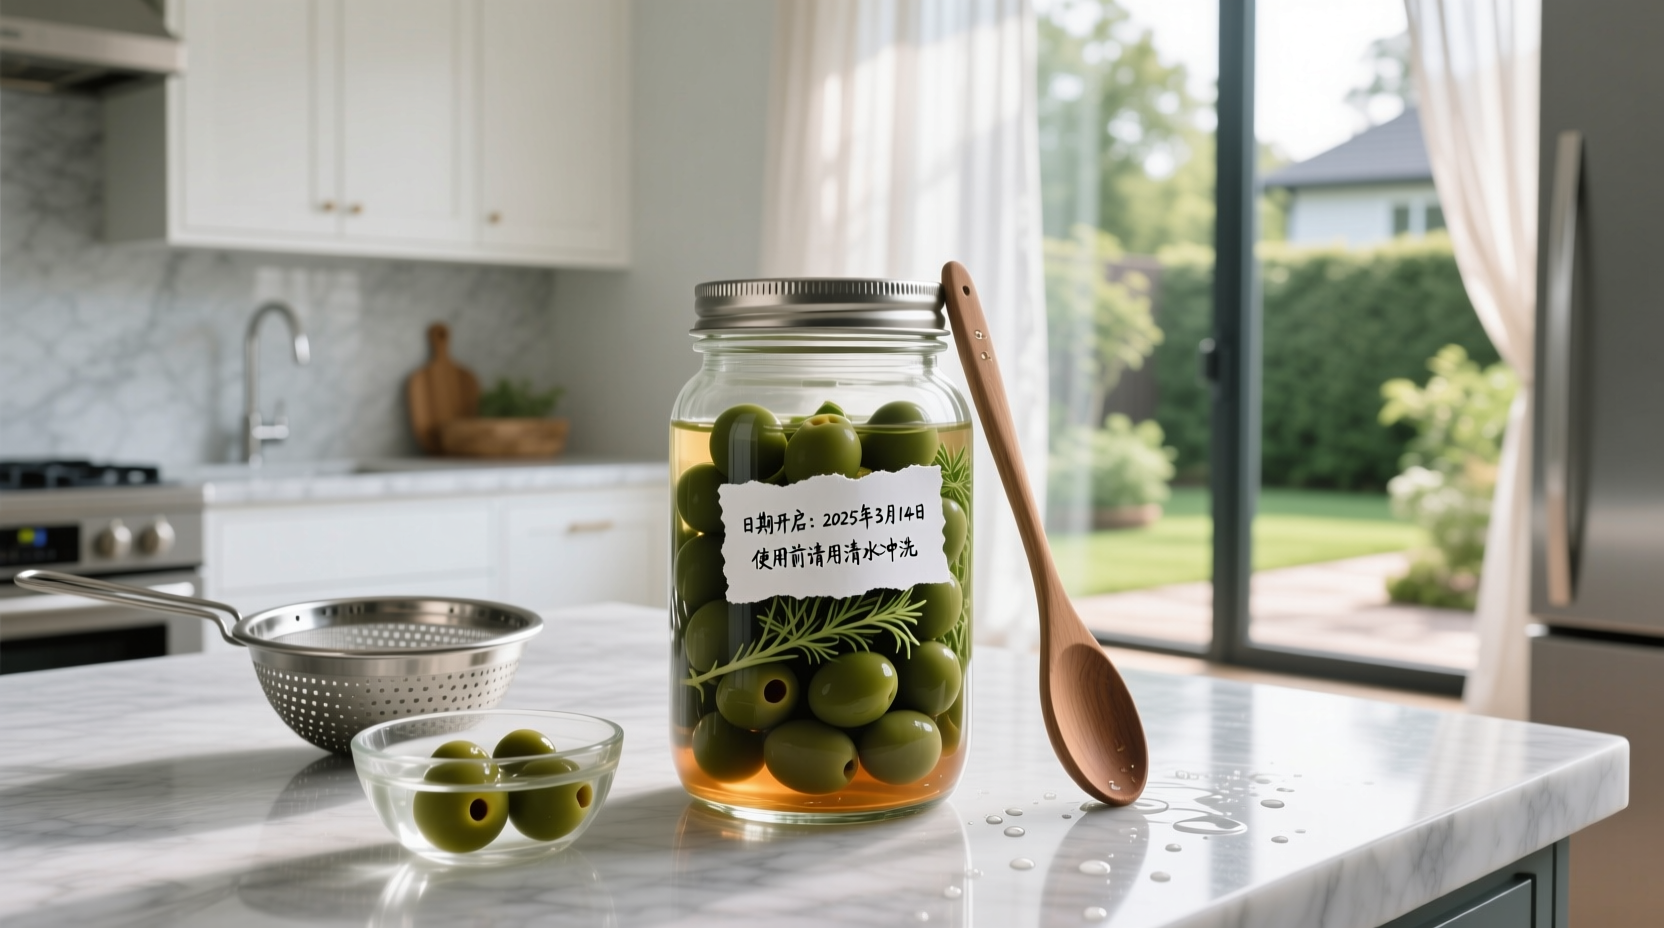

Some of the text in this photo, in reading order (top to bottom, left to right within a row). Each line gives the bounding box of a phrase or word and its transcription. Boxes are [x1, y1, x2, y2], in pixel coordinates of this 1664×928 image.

[751, 536, 918, 570] 使用前请用清水冲洗
